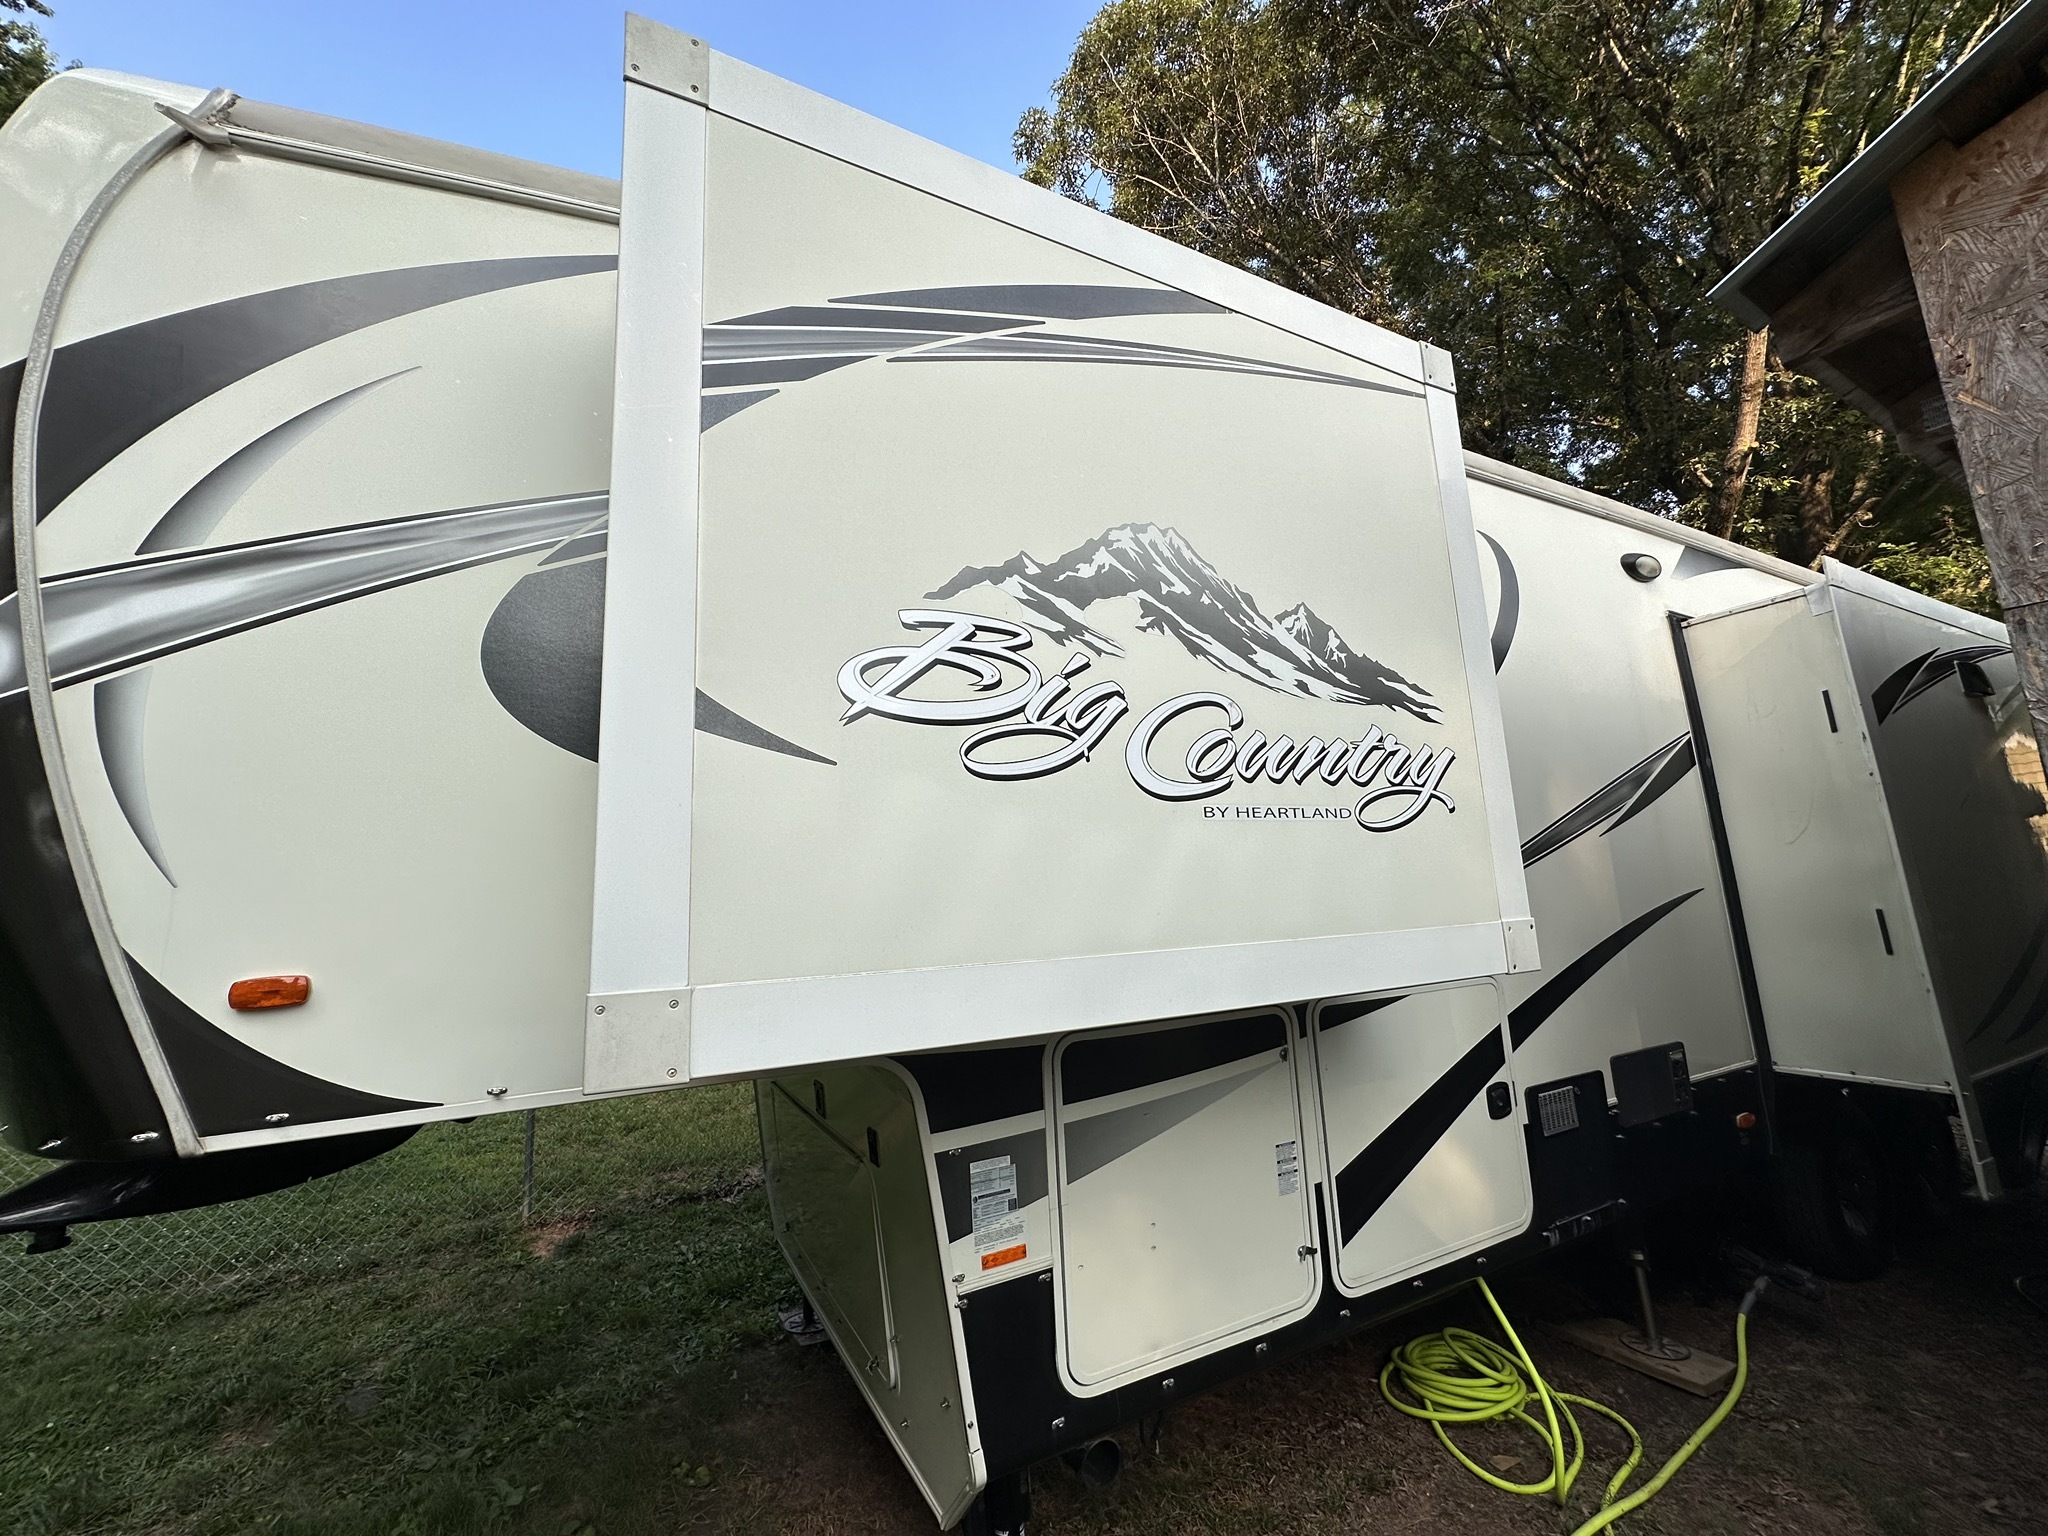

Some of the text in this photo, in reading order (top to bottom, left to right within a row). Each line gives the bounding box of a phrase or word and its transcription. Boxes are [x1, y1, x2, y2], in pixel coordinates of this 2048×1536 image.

[837, 609, 1456, 833] Big Country
[1203, 806, 1351, 819] BY HEARTLAND
